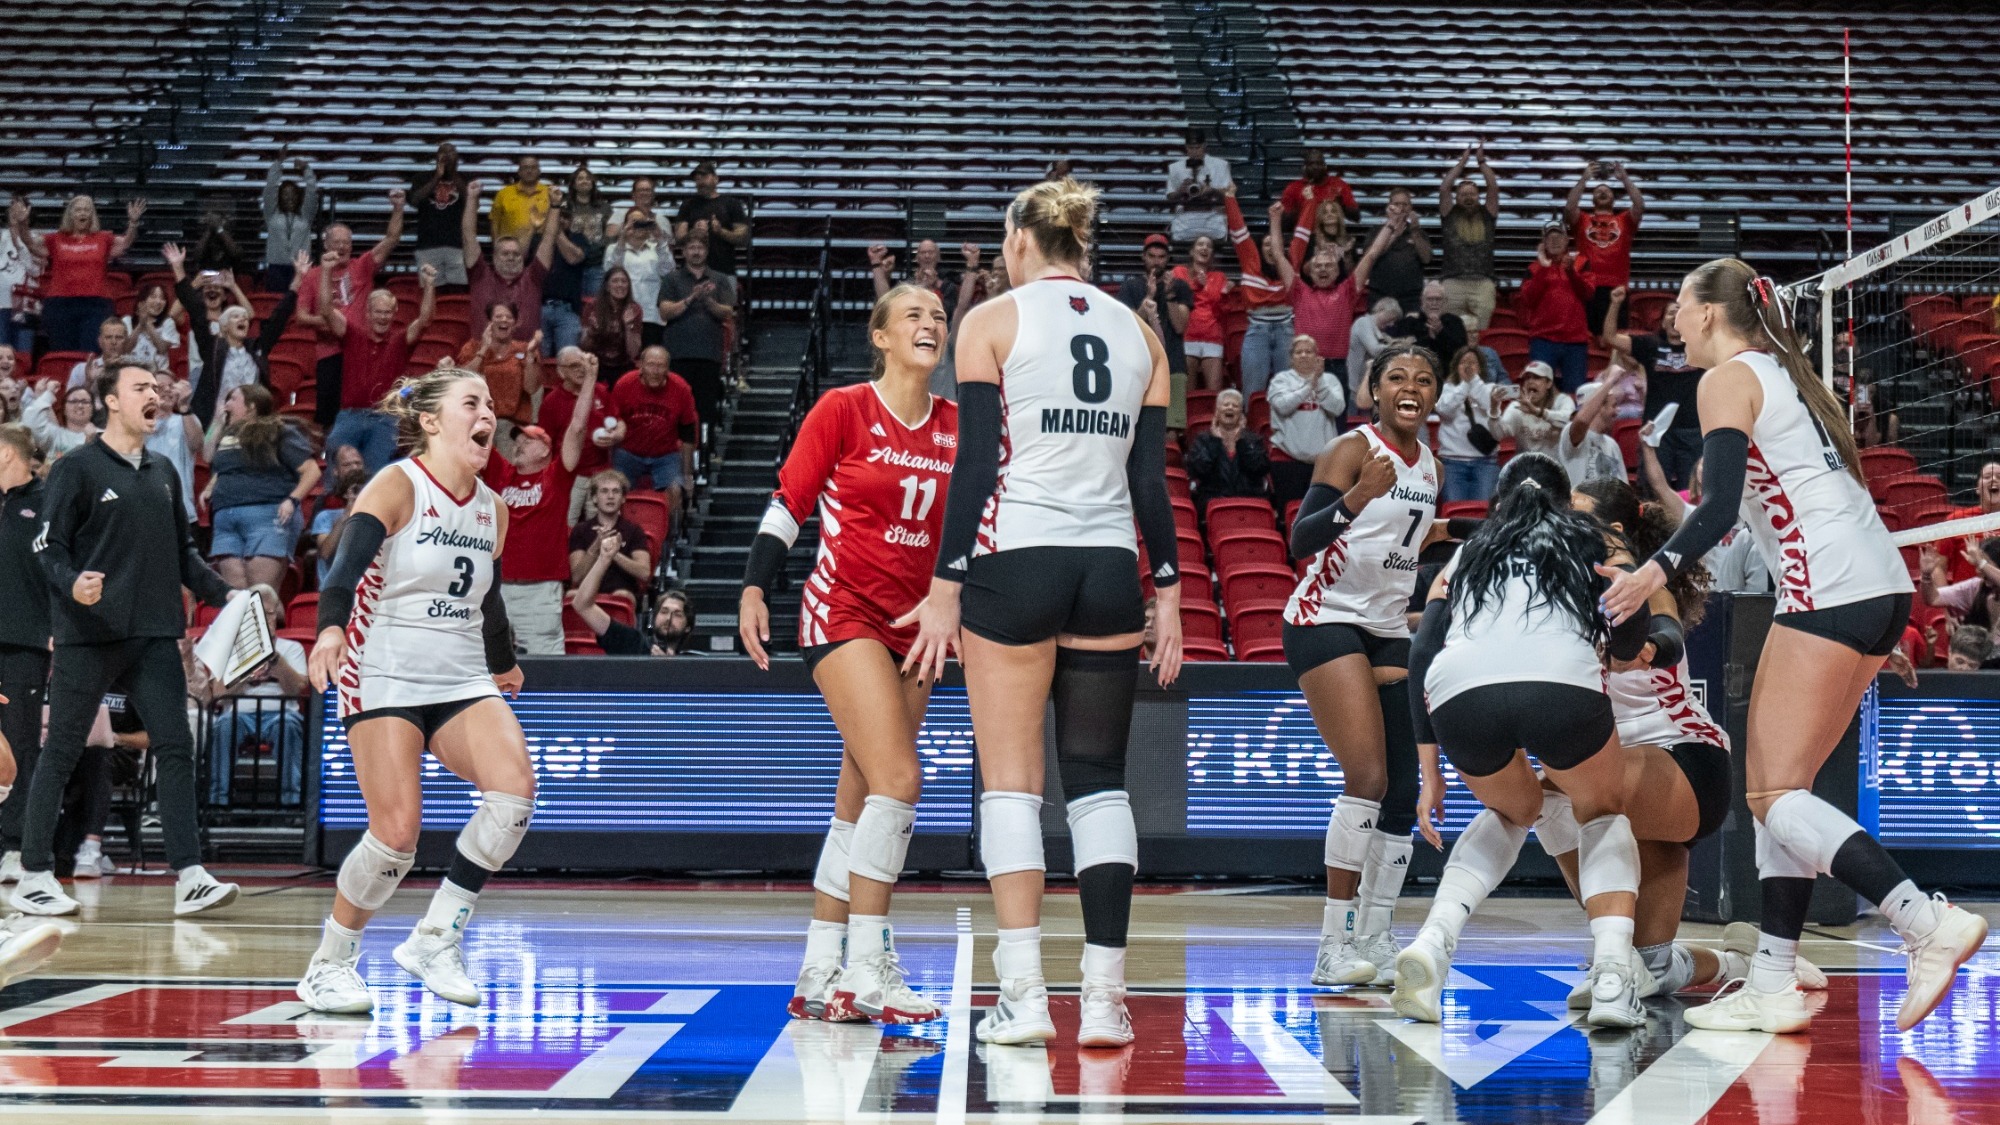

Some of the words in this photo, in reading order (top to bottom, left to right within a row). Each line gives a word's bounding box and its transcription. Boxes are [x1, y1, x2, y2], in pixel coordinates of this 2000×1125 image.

[1070, 334, 1112, 404] 8
[1041, 408, 1131, 439] MADIGAN
[933, 432, 957, 448] SBC
[866, 446, 954, 474] Arkansa
[899, 475, 937, 521] 11
[1388, 484, 1437, 506] Arkans
[416, 526, 494, 553] Arkansa
[884, 524, 930, 547] State
[1401, 508, 1424, 548] 7
[1383, 551, 1419, 571] State
[448, 555, 475, 598] 3
